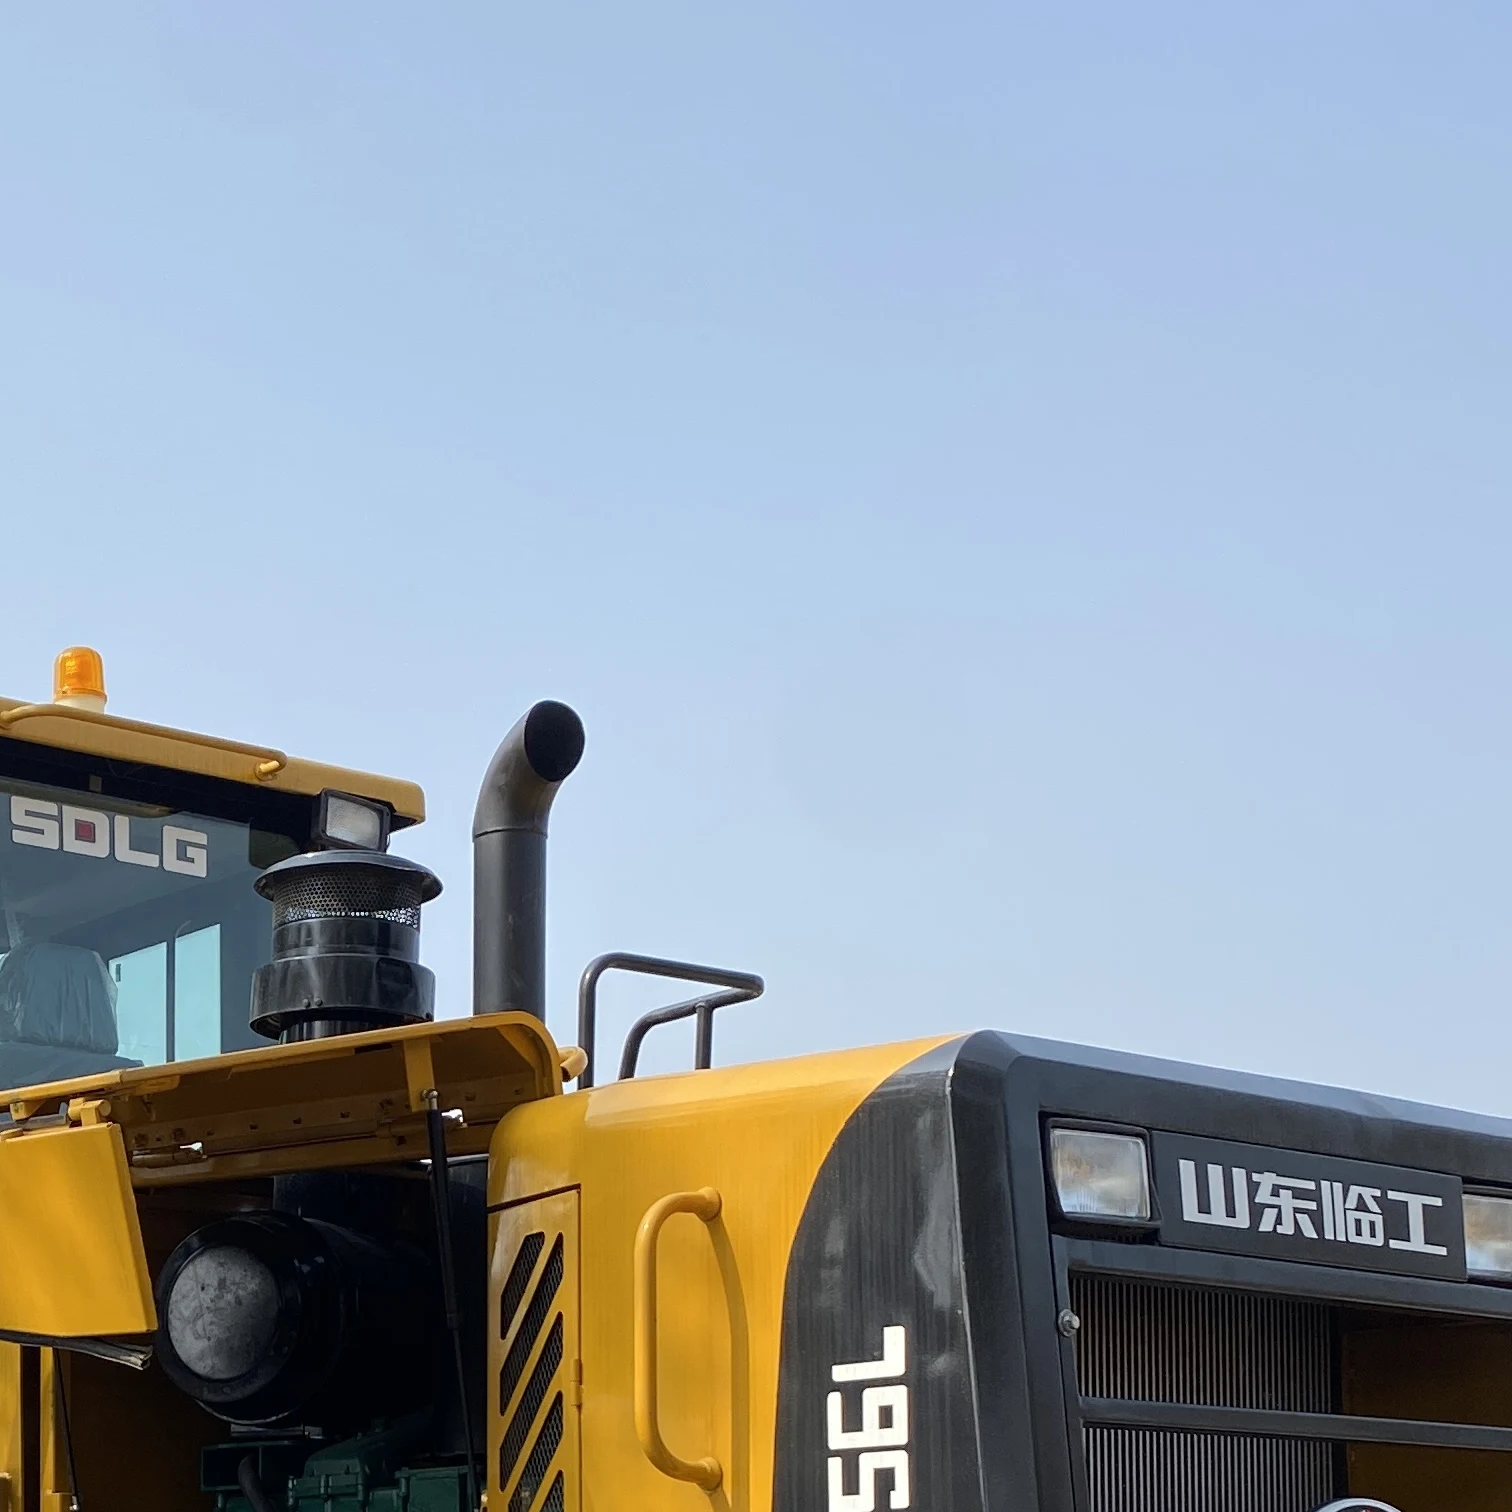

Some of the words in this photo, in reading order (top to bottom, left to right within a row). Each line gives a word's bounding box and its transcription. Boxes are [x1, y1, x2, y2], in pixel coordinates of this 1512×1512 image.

[10, 795, 208, 878] SDLG
[1178, 1158, 1448, 1256] 山东临工
